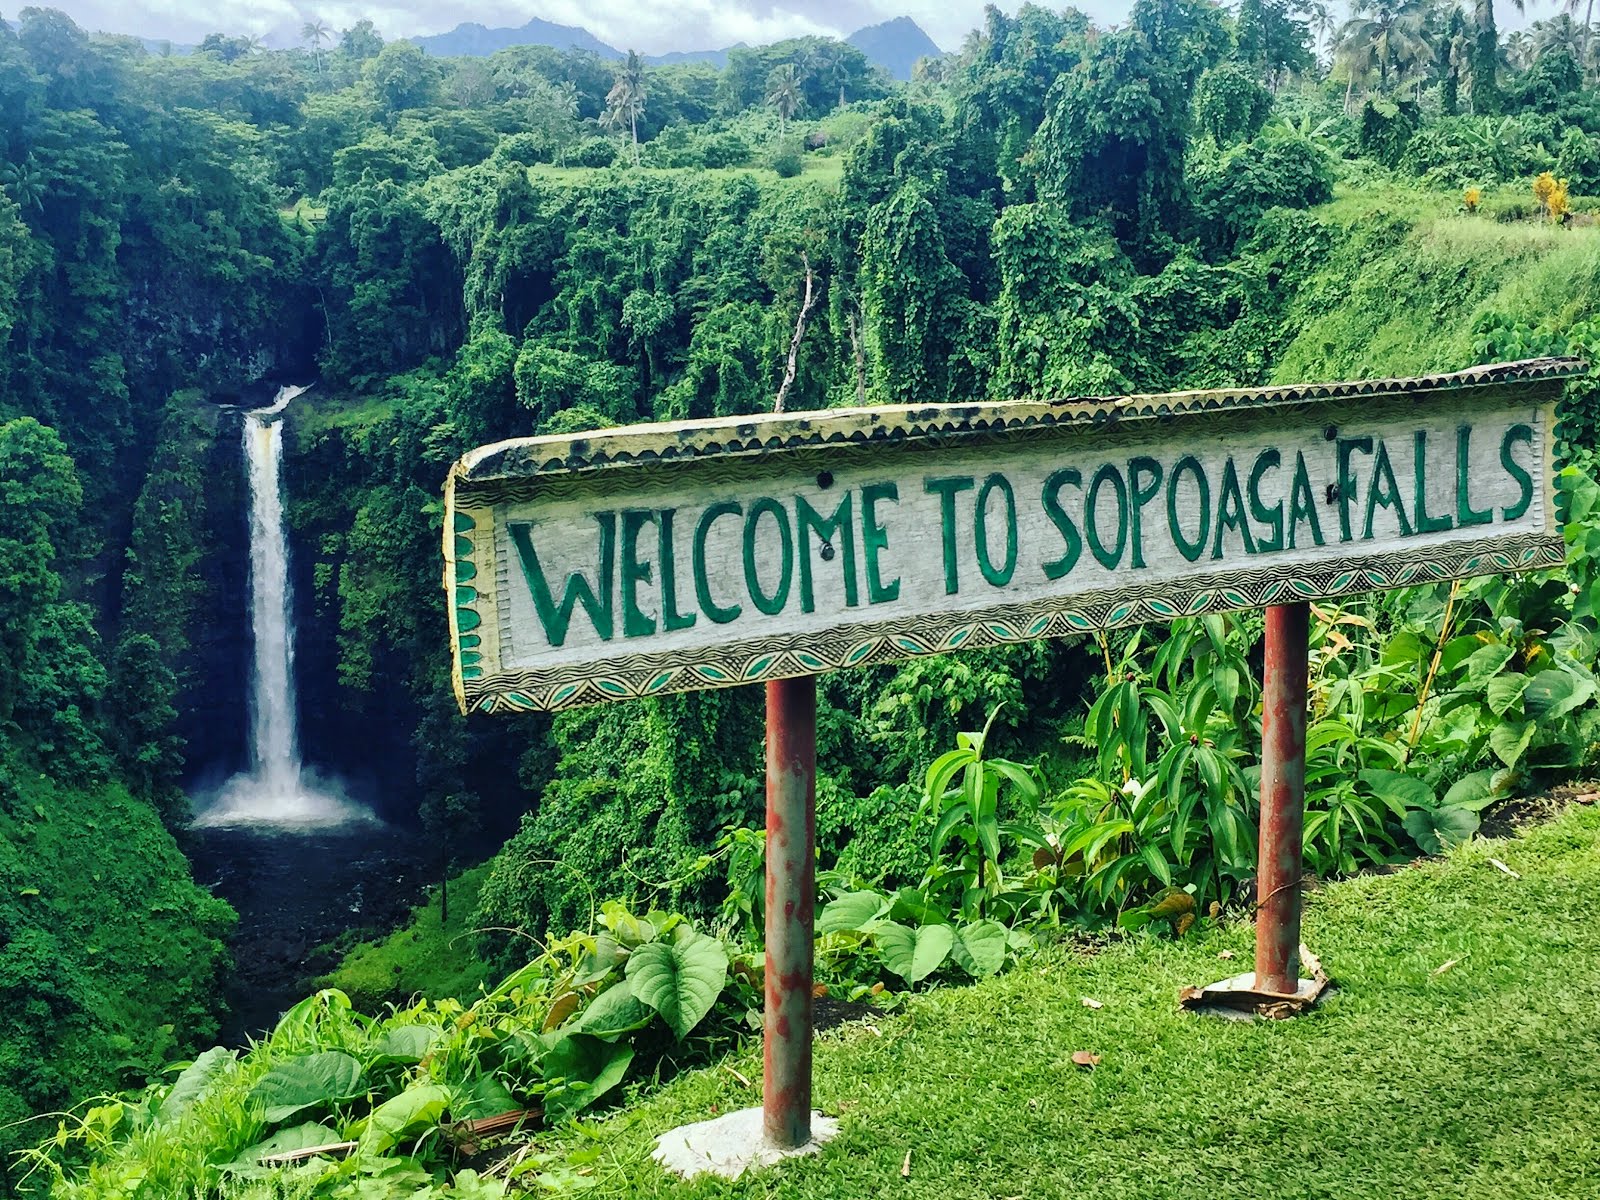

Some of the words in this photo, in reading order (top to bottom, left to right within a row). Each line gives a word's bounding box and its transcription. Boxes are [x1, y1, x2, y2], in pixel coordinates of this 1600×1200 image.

[507, 481, 901, 647] WELCOME
[923, 473, 1018, 595] TO
[1042, 447, 1325, 580] SOPOAGA
[1336, 424, 1534, 541] FALLS
